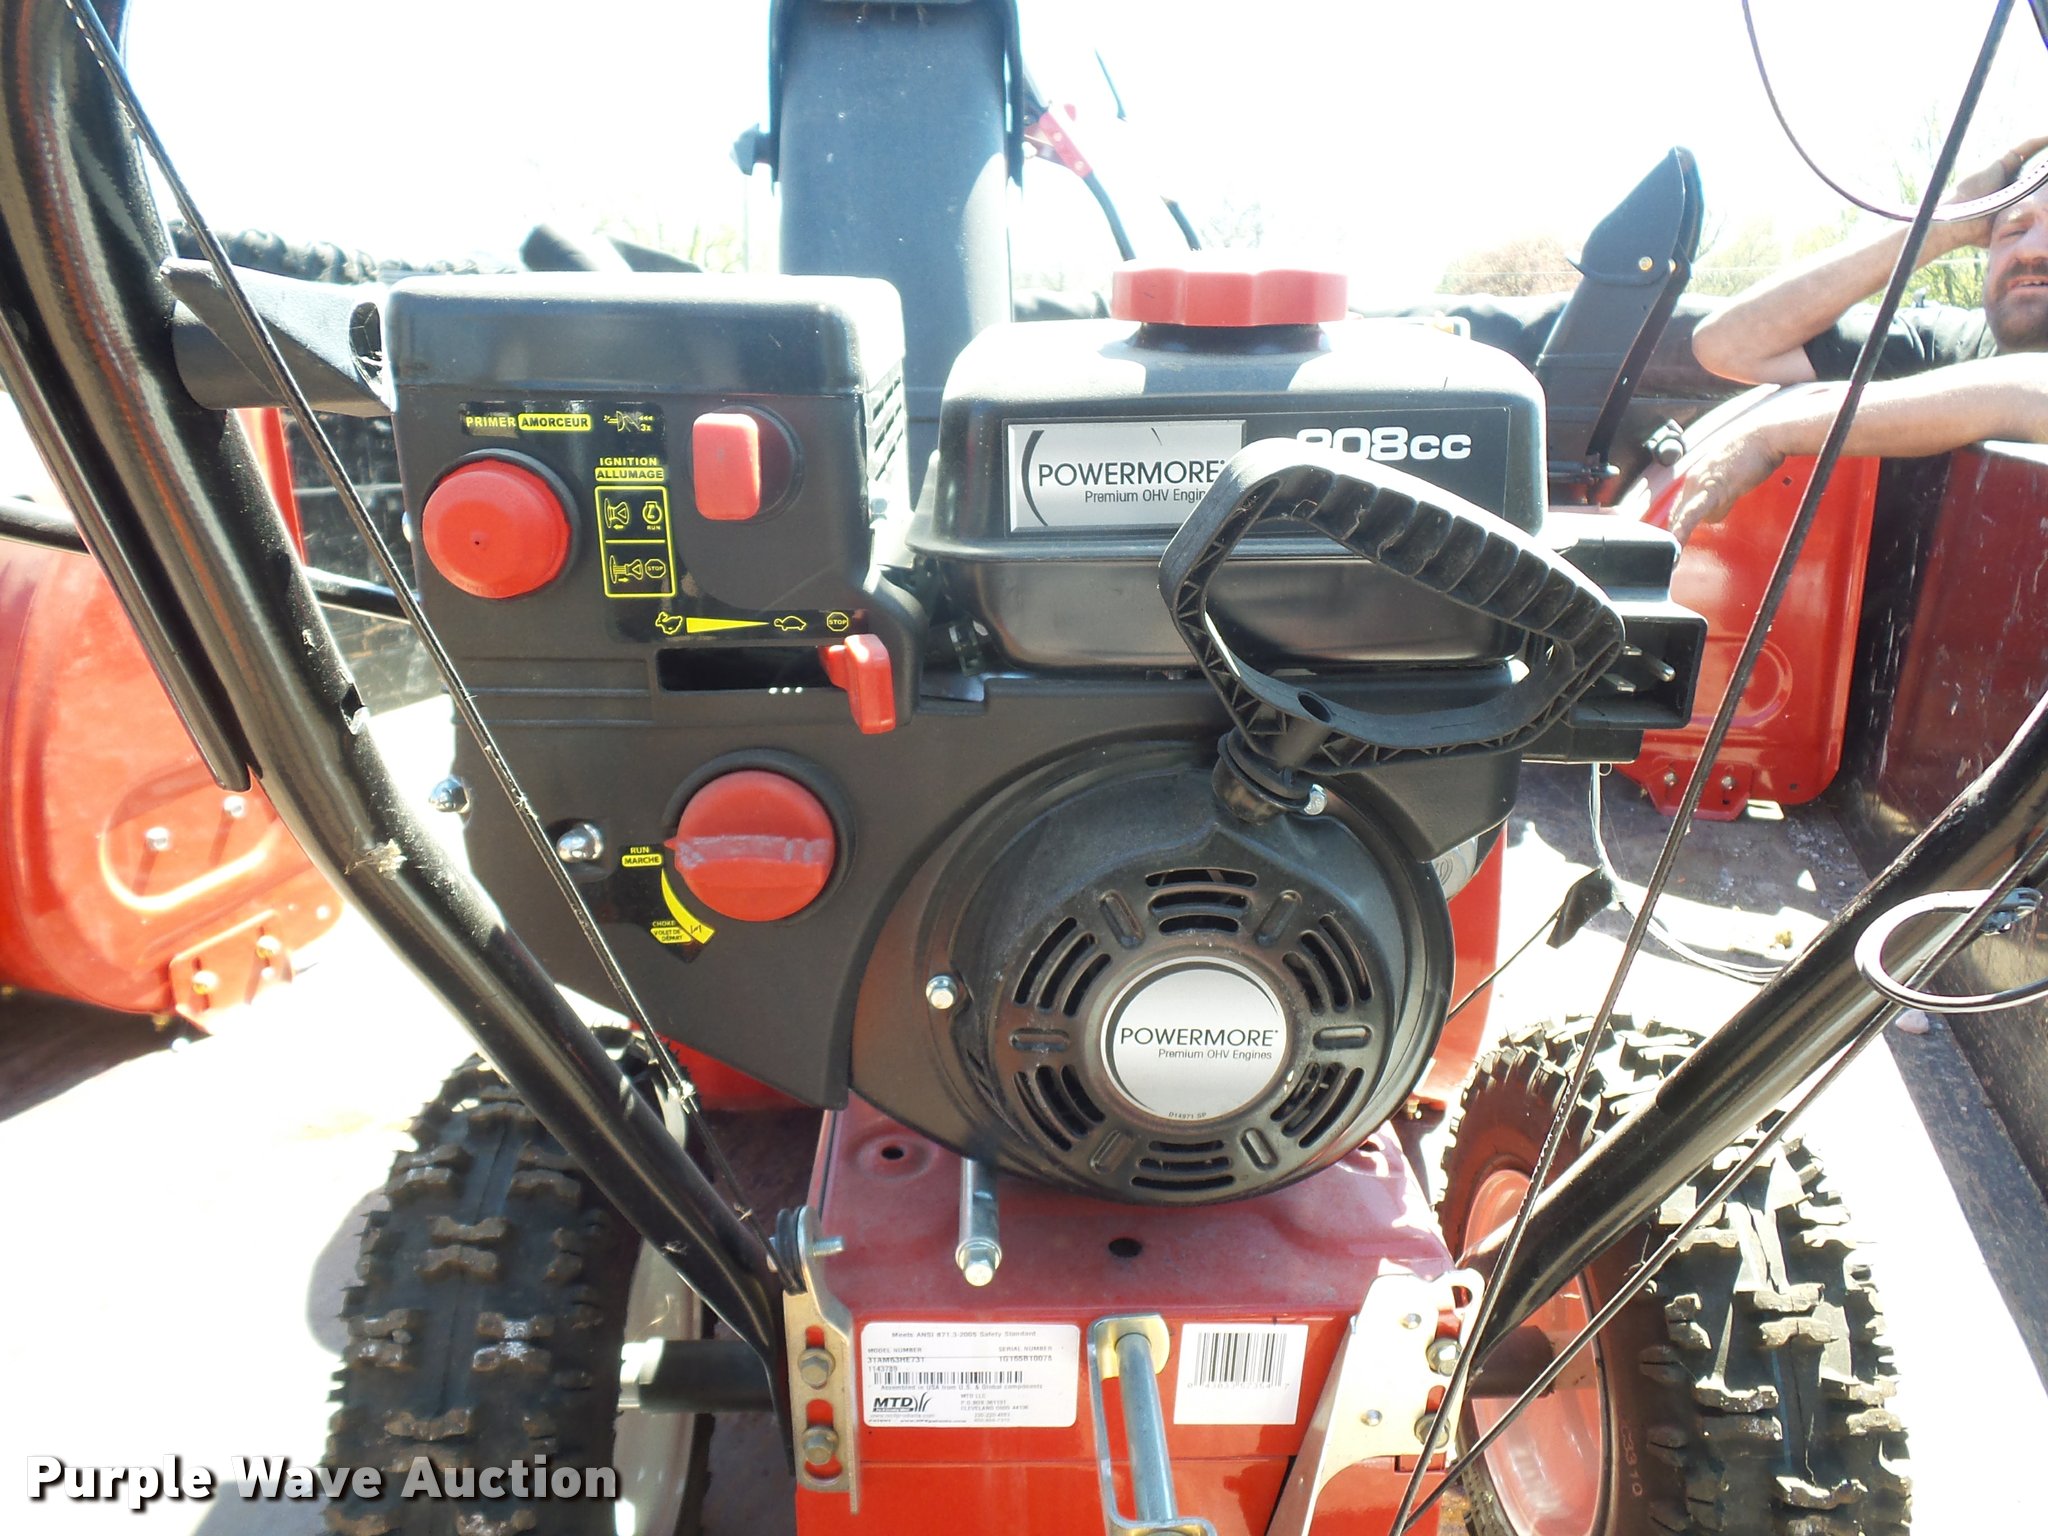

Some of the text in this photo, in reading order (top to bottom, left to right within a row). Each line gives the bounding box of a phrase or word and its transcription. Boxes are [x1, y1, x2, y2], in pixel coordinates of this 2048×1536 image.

[465, 416, 589, 428] PRIMER AMORCEUR
[599, 457, 657, 467] IGNITION
[596, 469, 664, 479] ALLUMAGE
[1038, 460, 1220, 487] POWERMORE
[1085, 488, 1206, 504] Premium OHV Engin
[630, 846, 650, 854] RUN
[624, 856, 660, 865] MARCHE
[1120, 1027, 1274, 1047] POWERMORE
[1158, 1048, 1273, 1062] Premium OHV Engines
[979, 1330, 1002, 1338] Safety
[873, 1397, 913, 1408] MTD
